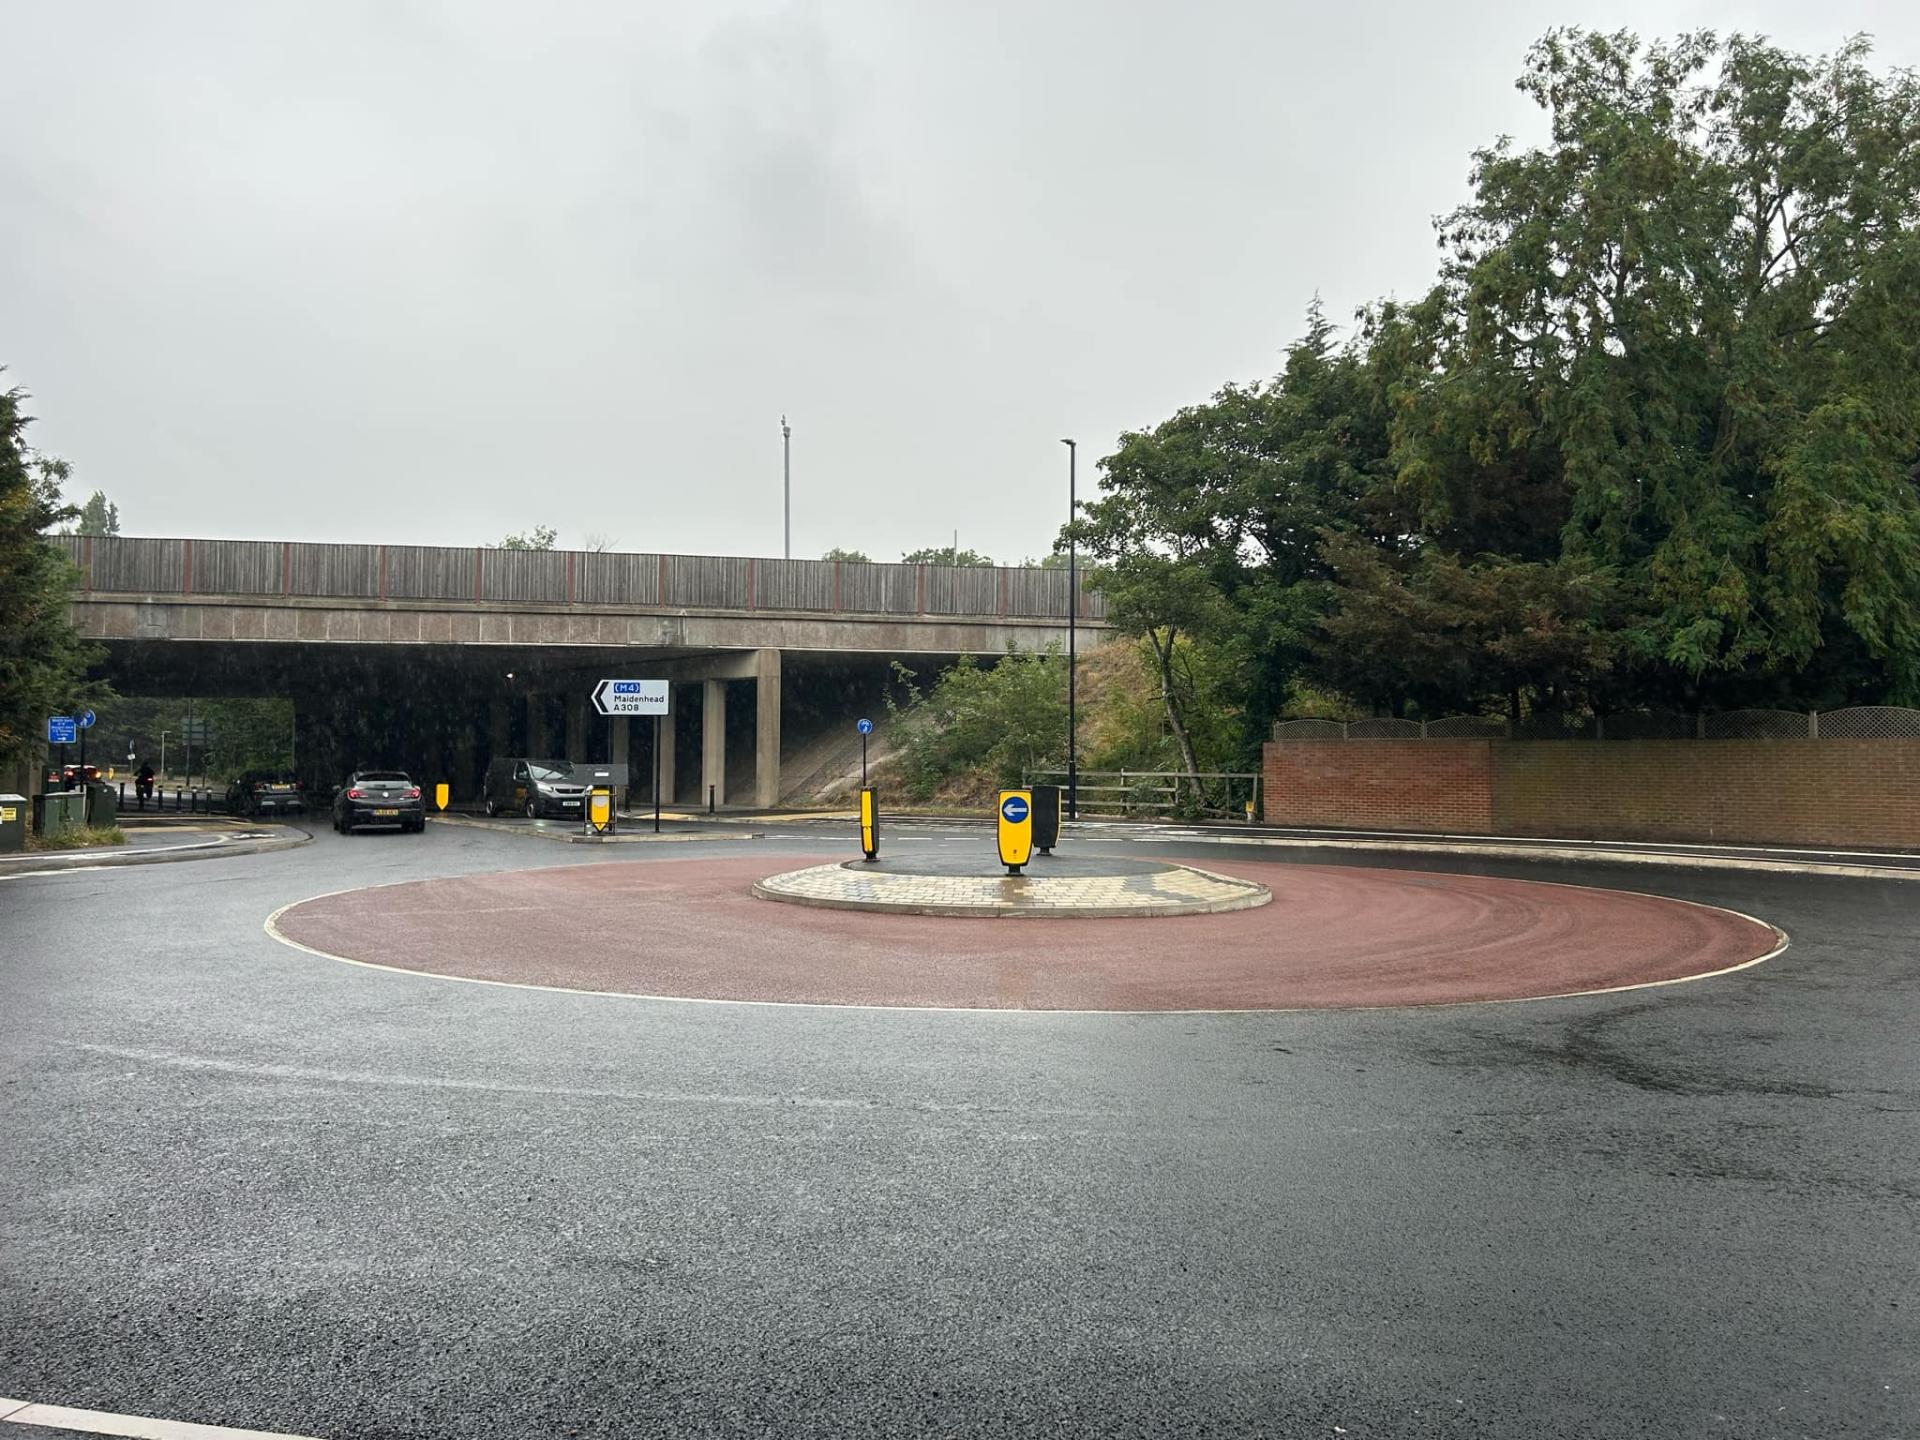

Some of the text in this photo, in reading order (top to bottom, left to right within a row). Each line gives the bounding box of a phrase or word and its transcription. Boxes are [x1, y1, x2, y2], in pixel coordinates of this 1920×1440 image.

[614, 683, 640, 693] (M4)
[614, 695, 664, 703] Maidenhead
[614, 704, 639, 712] A308
